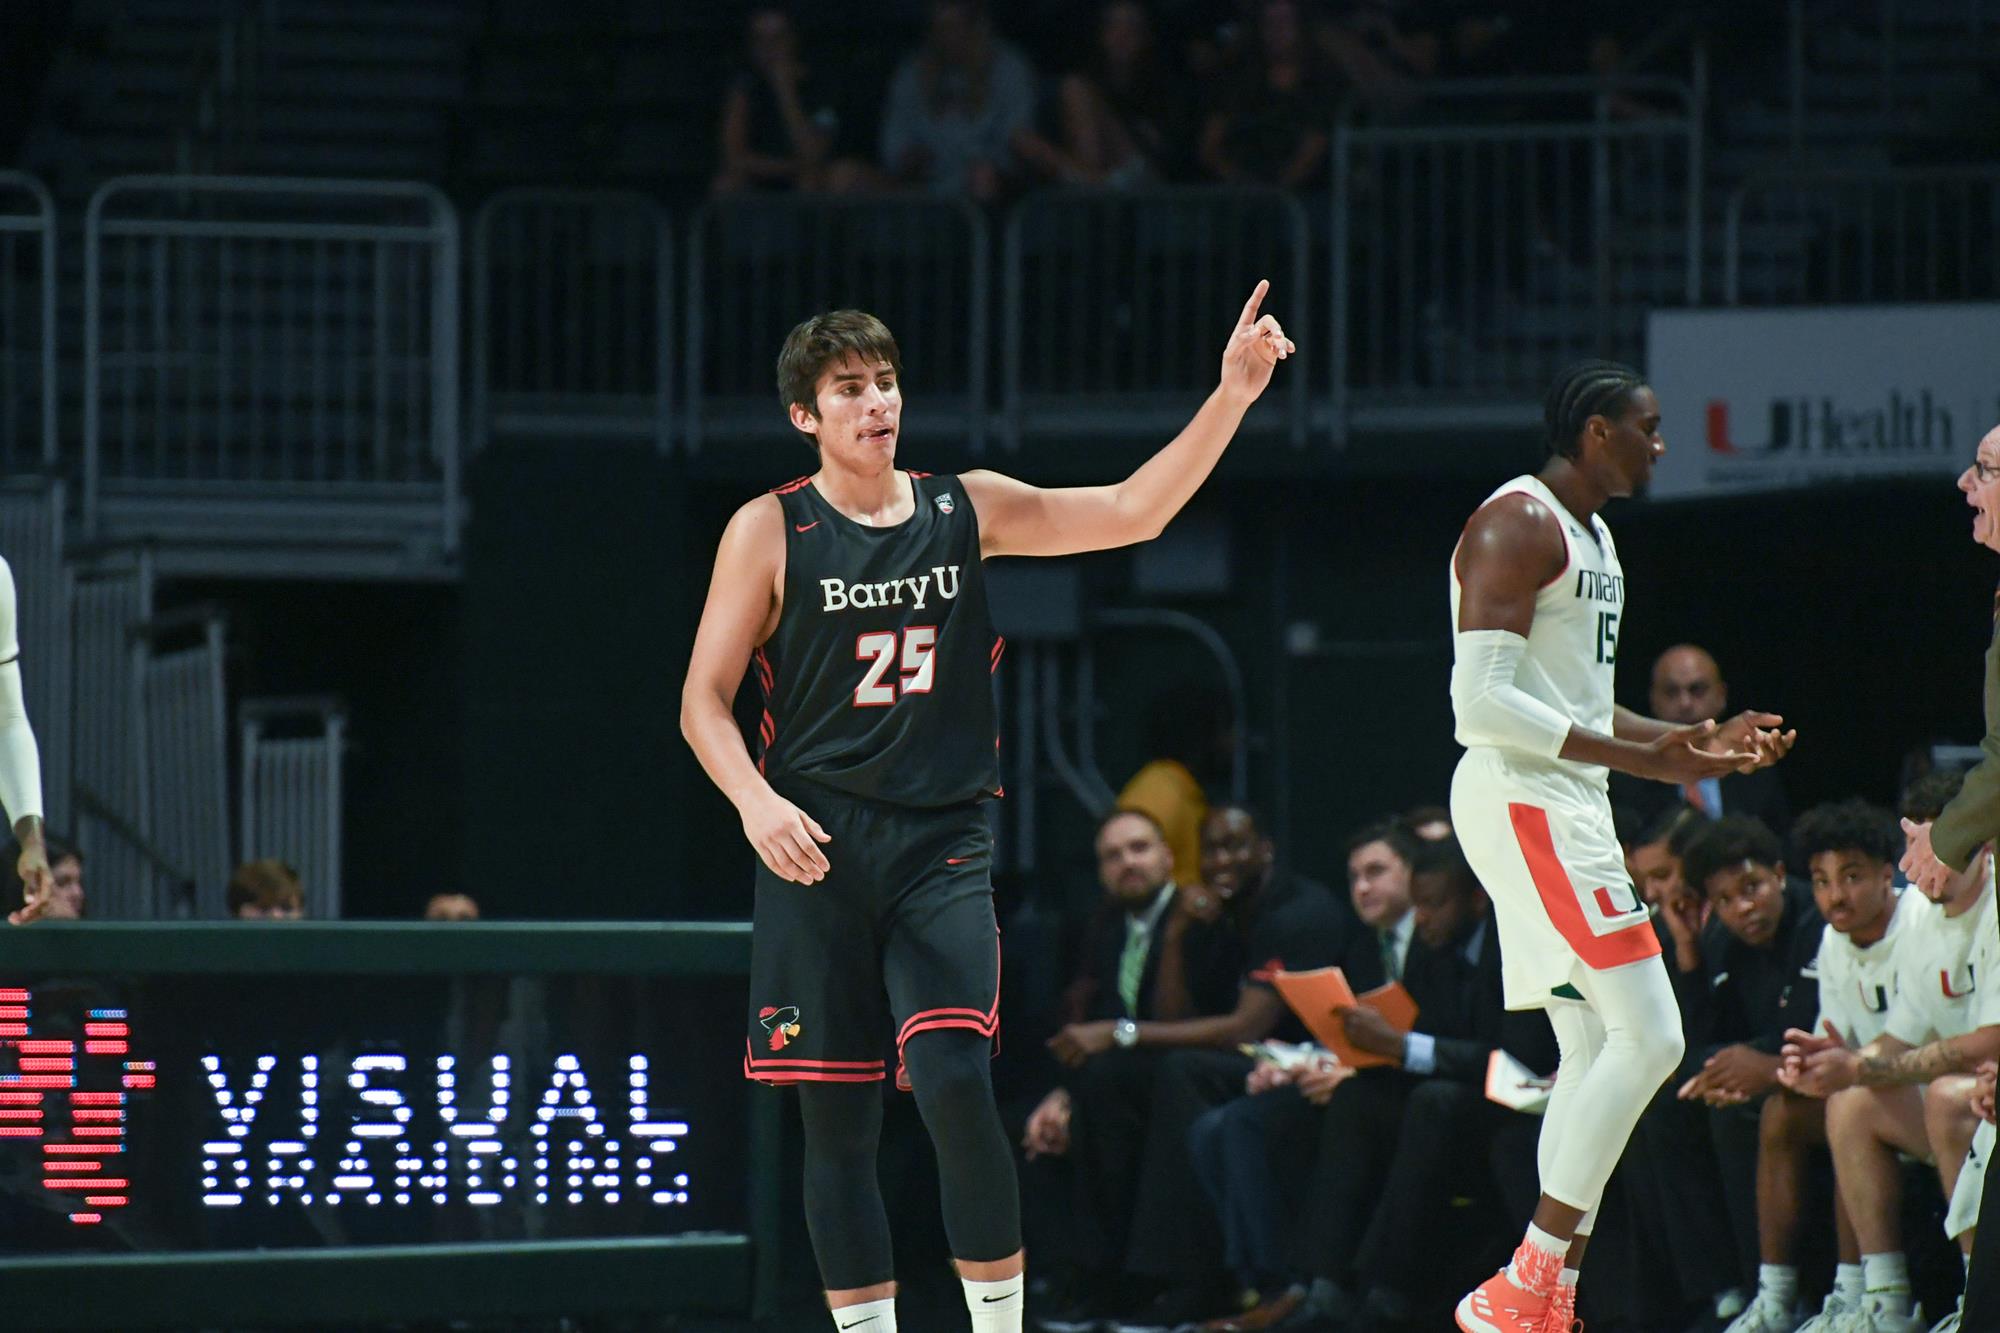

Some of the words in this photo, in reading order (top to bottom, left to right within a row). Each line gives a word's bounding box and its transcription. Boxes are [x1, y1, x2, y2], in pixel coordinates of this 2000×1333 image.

[820, 575, 930, 612] Barry
[931, 565, 960, 600] U
[1596, 611, 1618, 665] 15
[853, 625, 938, 707] 25
[1593, 882, 1644, 918] U
[1858, 979, 1889, 1014] U
[1940, 963, 1976, 999] U
[200, 1054, 690, 1138] VISUAL
